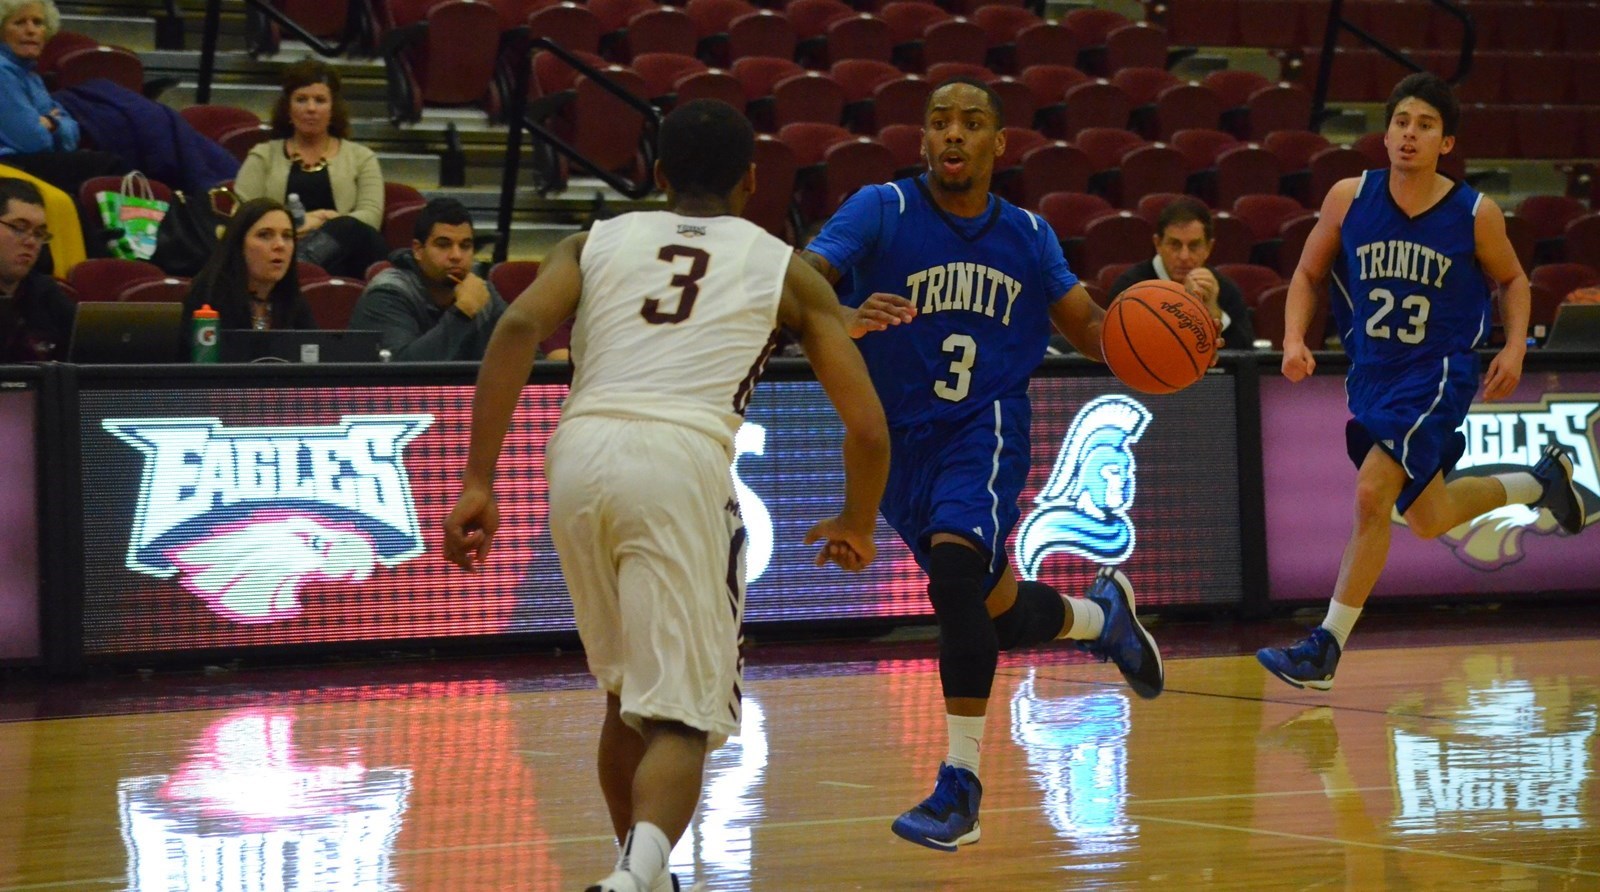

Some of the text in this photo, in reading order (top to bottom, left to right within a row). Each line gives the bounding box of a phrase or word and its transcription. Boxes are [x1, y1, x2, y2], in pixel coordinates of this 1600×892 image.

[640, 244, 711, 325] 3
[906, 262, 1022, 326] TRINITY
[1356, 240, 1452, 288] TRINITY
[197, 326, 217, 346] G
[1160, 301, 1211, 353] Rawlings
[1365, 287, 1431, 344] 23
[933, 333, 977, 402] 3
[120, 422, 420, 540] EAGLES
